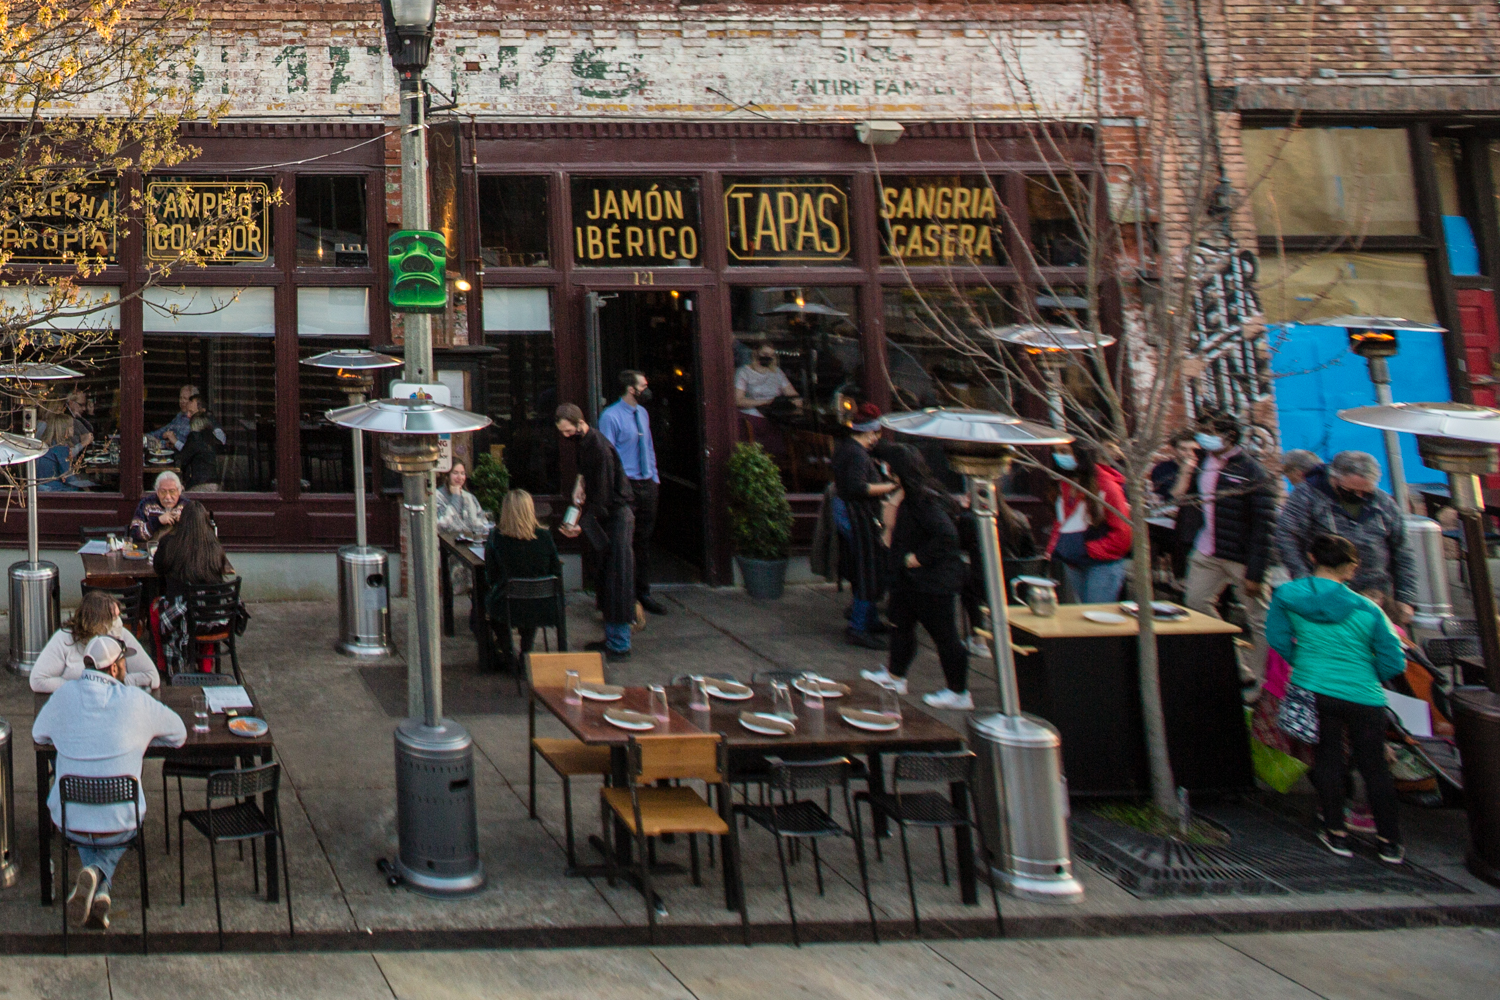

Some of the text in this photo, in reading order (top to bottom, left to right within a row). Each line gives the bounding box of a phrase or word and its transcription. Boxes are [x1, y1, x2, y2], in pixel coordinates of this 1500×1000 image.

[586, 184, 684, 221] JAMÓN
[880, 186, 997, 219] SANGRIA
[3, 228, 108, 250] PROPIA
[154, 223, 262, 253] COMEDOR
[730, 192, 841, 254] TAPAS
[575, 223, 697, 260] IBÉRICO
[888, 224, 993, 258] CASERA
[632, 272, 654, 286] 121
